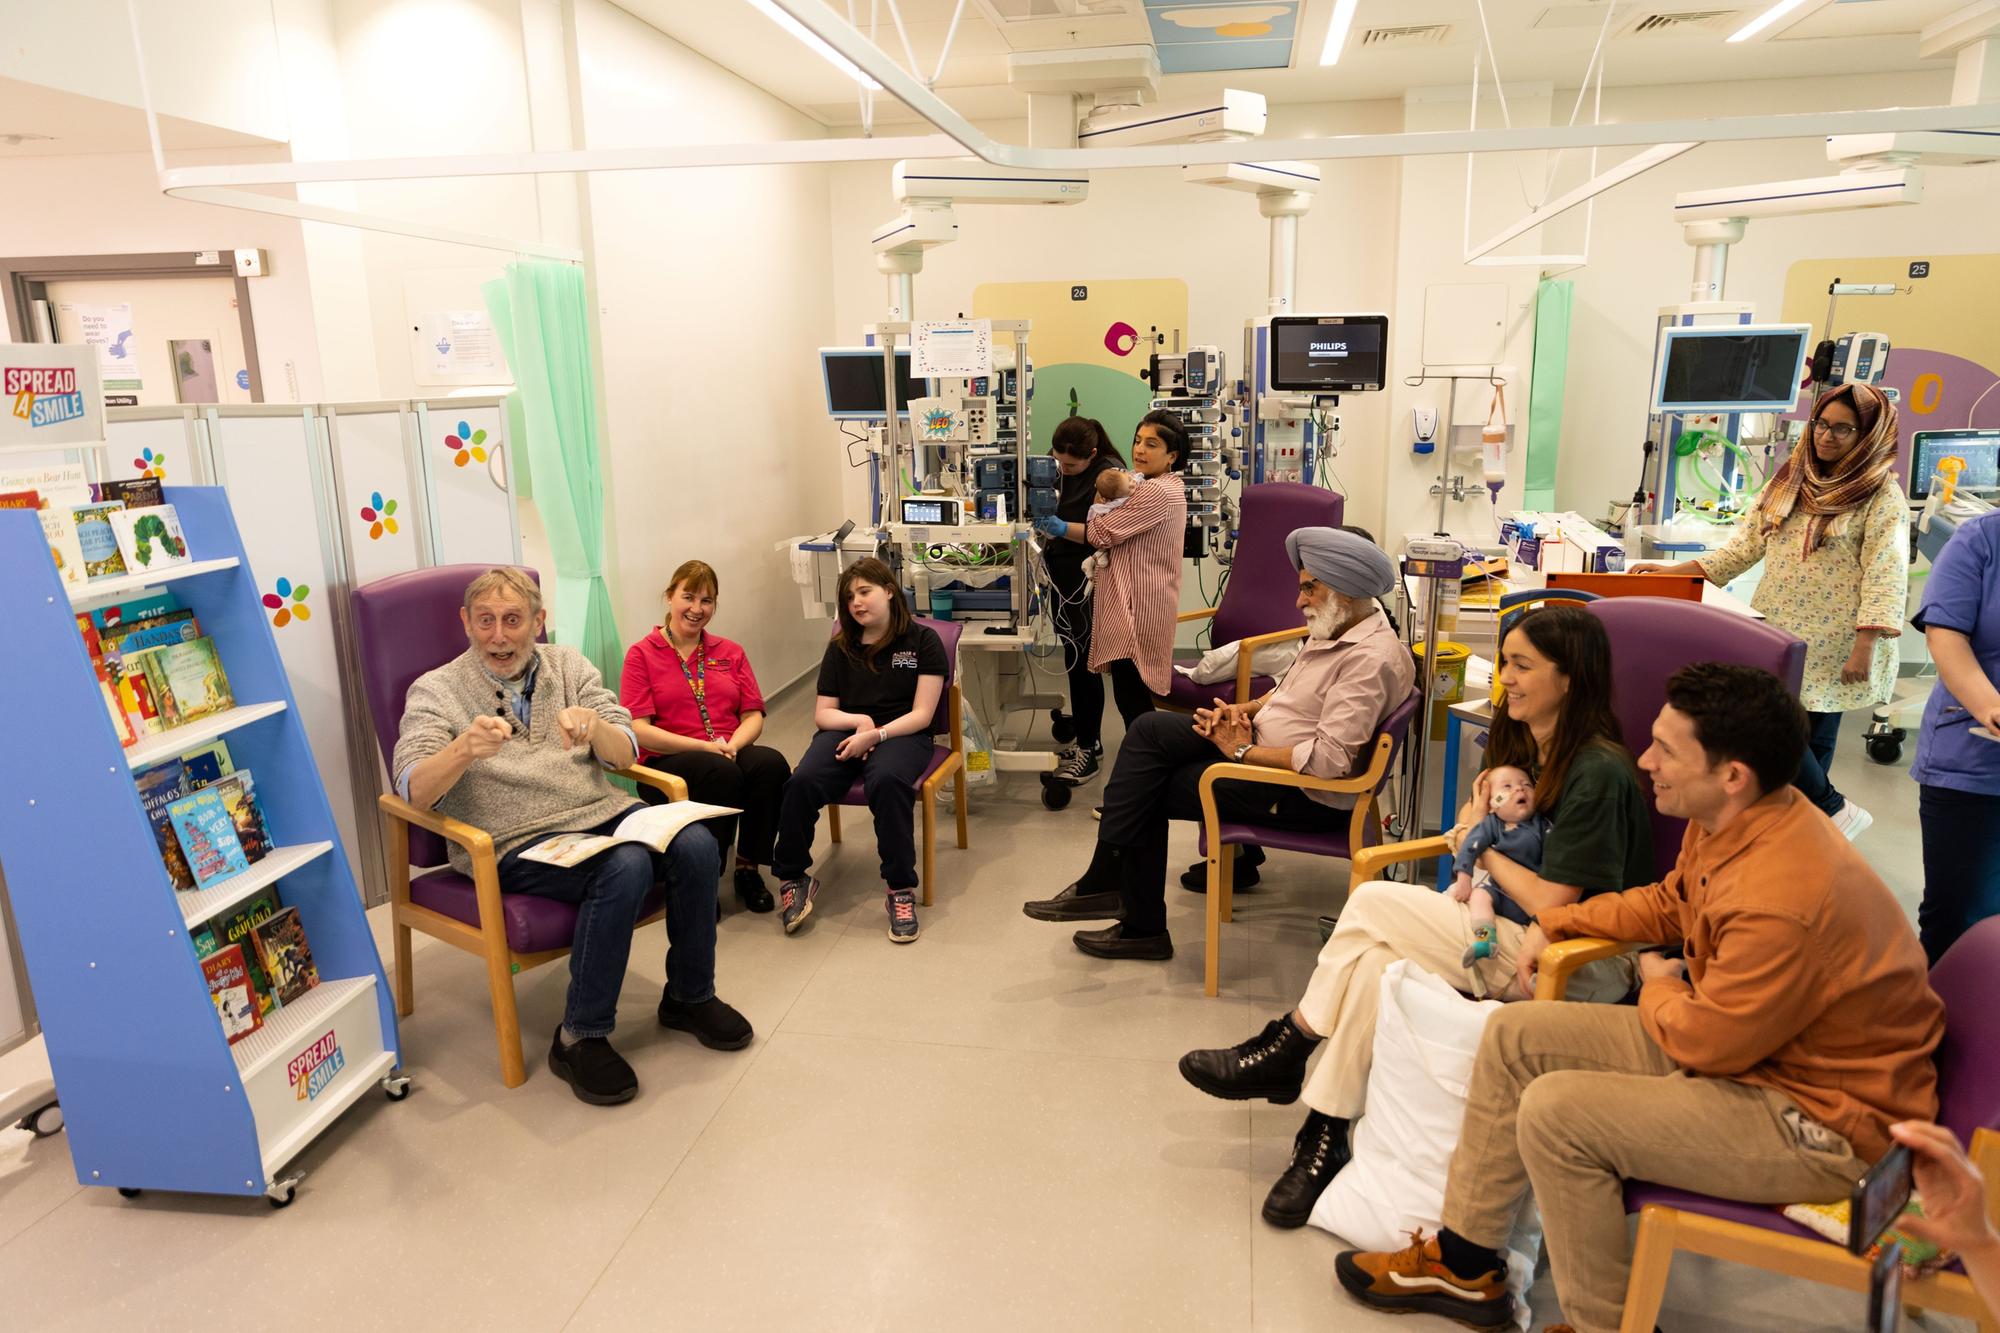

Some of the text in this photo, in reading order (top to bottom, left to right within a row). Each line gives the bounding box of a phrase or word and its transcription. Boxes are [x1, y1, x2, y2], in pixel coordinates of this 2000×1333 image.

[1912, 264, 1926, 275] 25
[1073, 288, 1085, 298] 26
[83, 322, 98, 330] need
[1310, 342, 1347, 350] PHILIPS
[7, 369, 75, 394] SPREAD
[16, 393, 82, 425] A SMILE
[930, 416, 950, 430] LEO
[43, 470, 62, 483] Bear
[62, 469, 81, 481] Hunt
[126, 661, 140, 672] ar
[892, 659, 918, 669] PAS
[144, 787, 180, 810] UFFALO'S
[209, 815, 228, 832] VERY
[195, 936, 217, 953] Squ
[206, 954, 233, 975] DIARY
[290, 1033, 336, 1086] SPREAD
[299, 1048, 343, 1099] A SMILE
